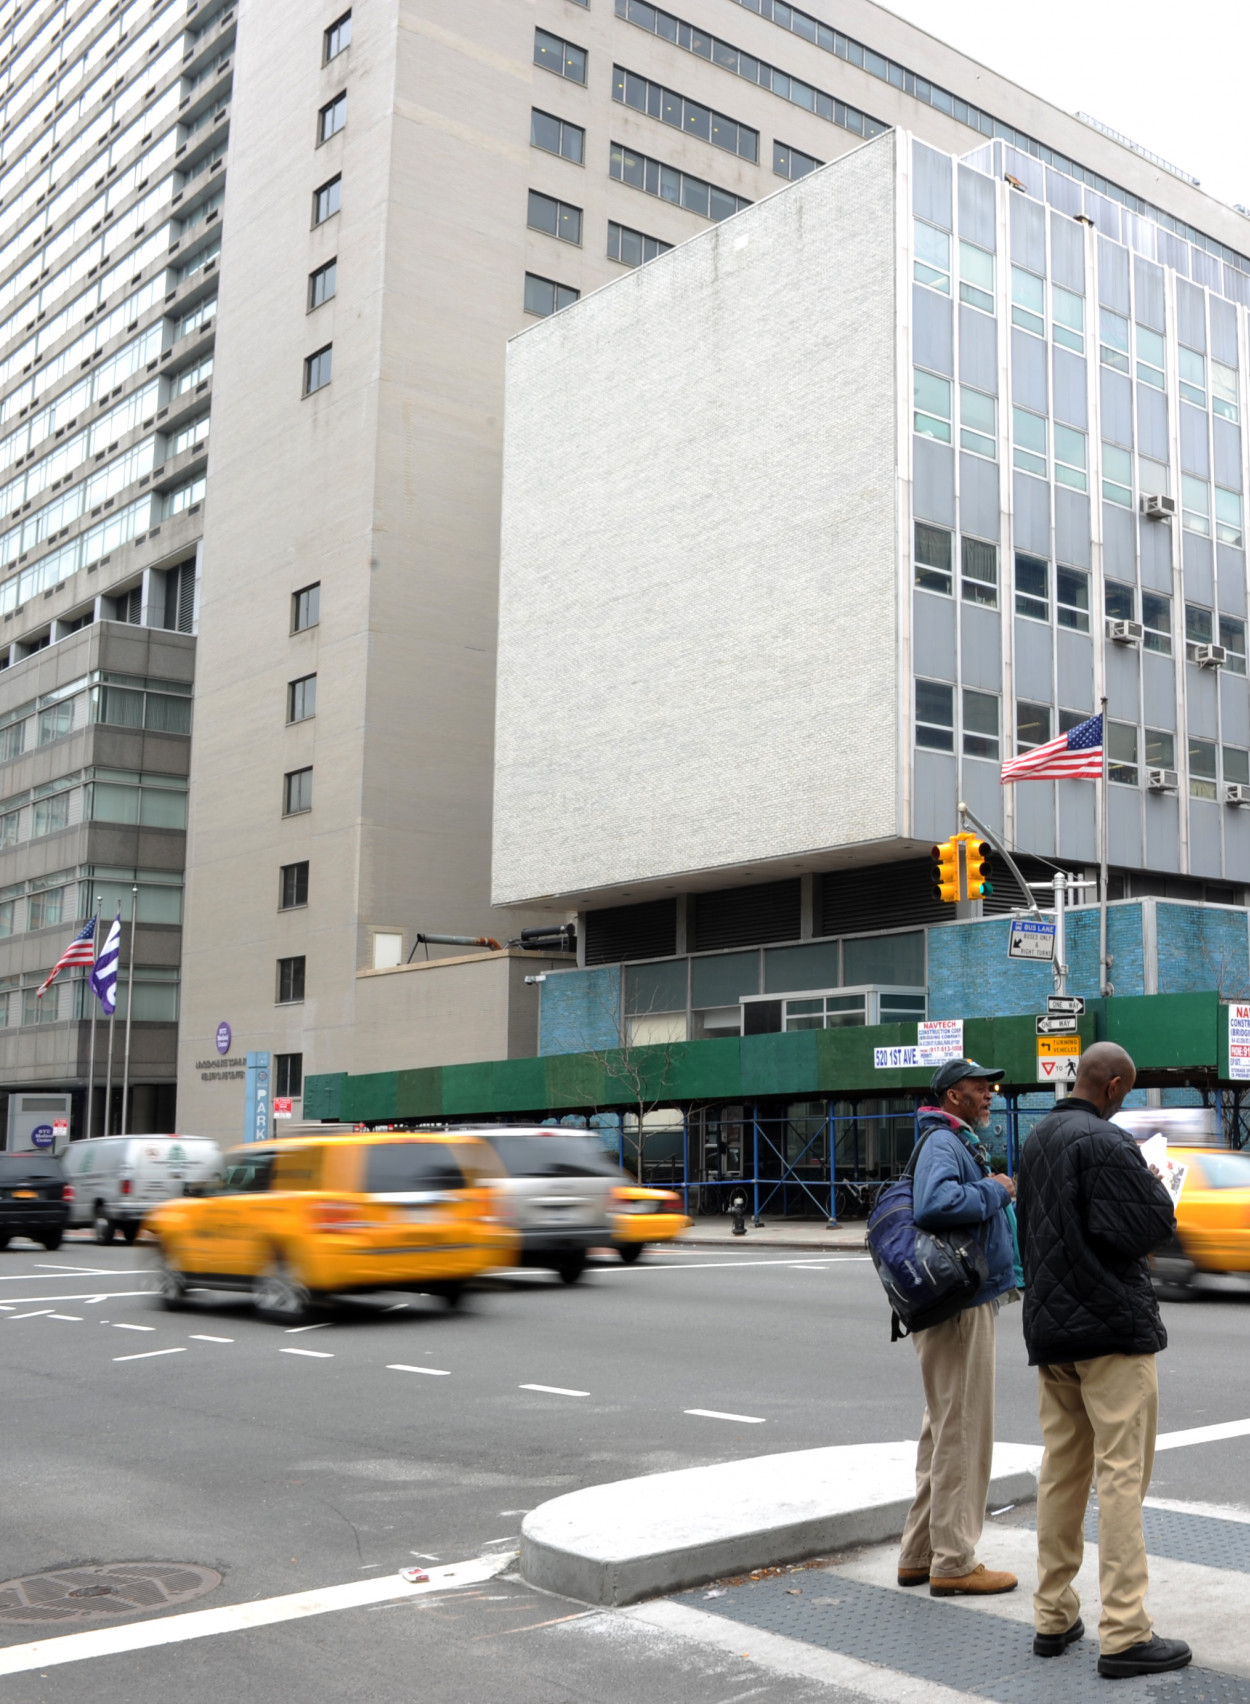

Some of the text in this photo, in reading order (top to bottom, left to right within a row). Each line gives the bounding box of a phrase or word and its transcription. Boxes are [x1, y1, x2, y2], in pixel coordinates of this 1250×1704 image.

[1038, 925, 1054, 933] LANE
[876, 1050, 888, 1066] 520
[890, 1049, 902, 1066] 1ST
[903, 1048, 918, 1065] AVE.
